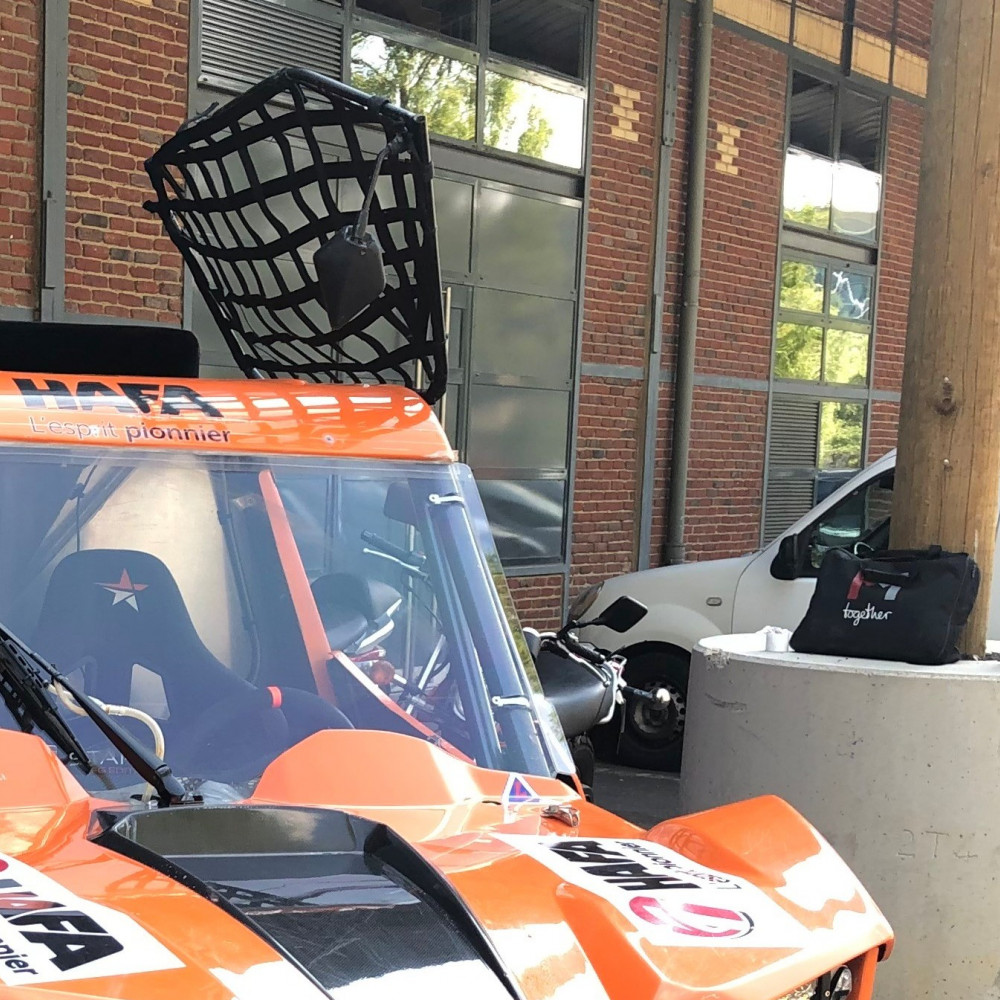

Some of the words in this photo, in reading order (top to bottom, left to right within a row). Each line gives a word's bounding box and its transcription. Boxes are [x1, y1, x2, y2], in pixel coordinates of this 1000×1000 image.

[12, 378, 224, 418] HAFA
[29, 415, 118, 439] L'espit
[125, 423, 231, 443] pionnier
[843, 602, 893, 626] together
[540, 841, 702, 891] HAFA
